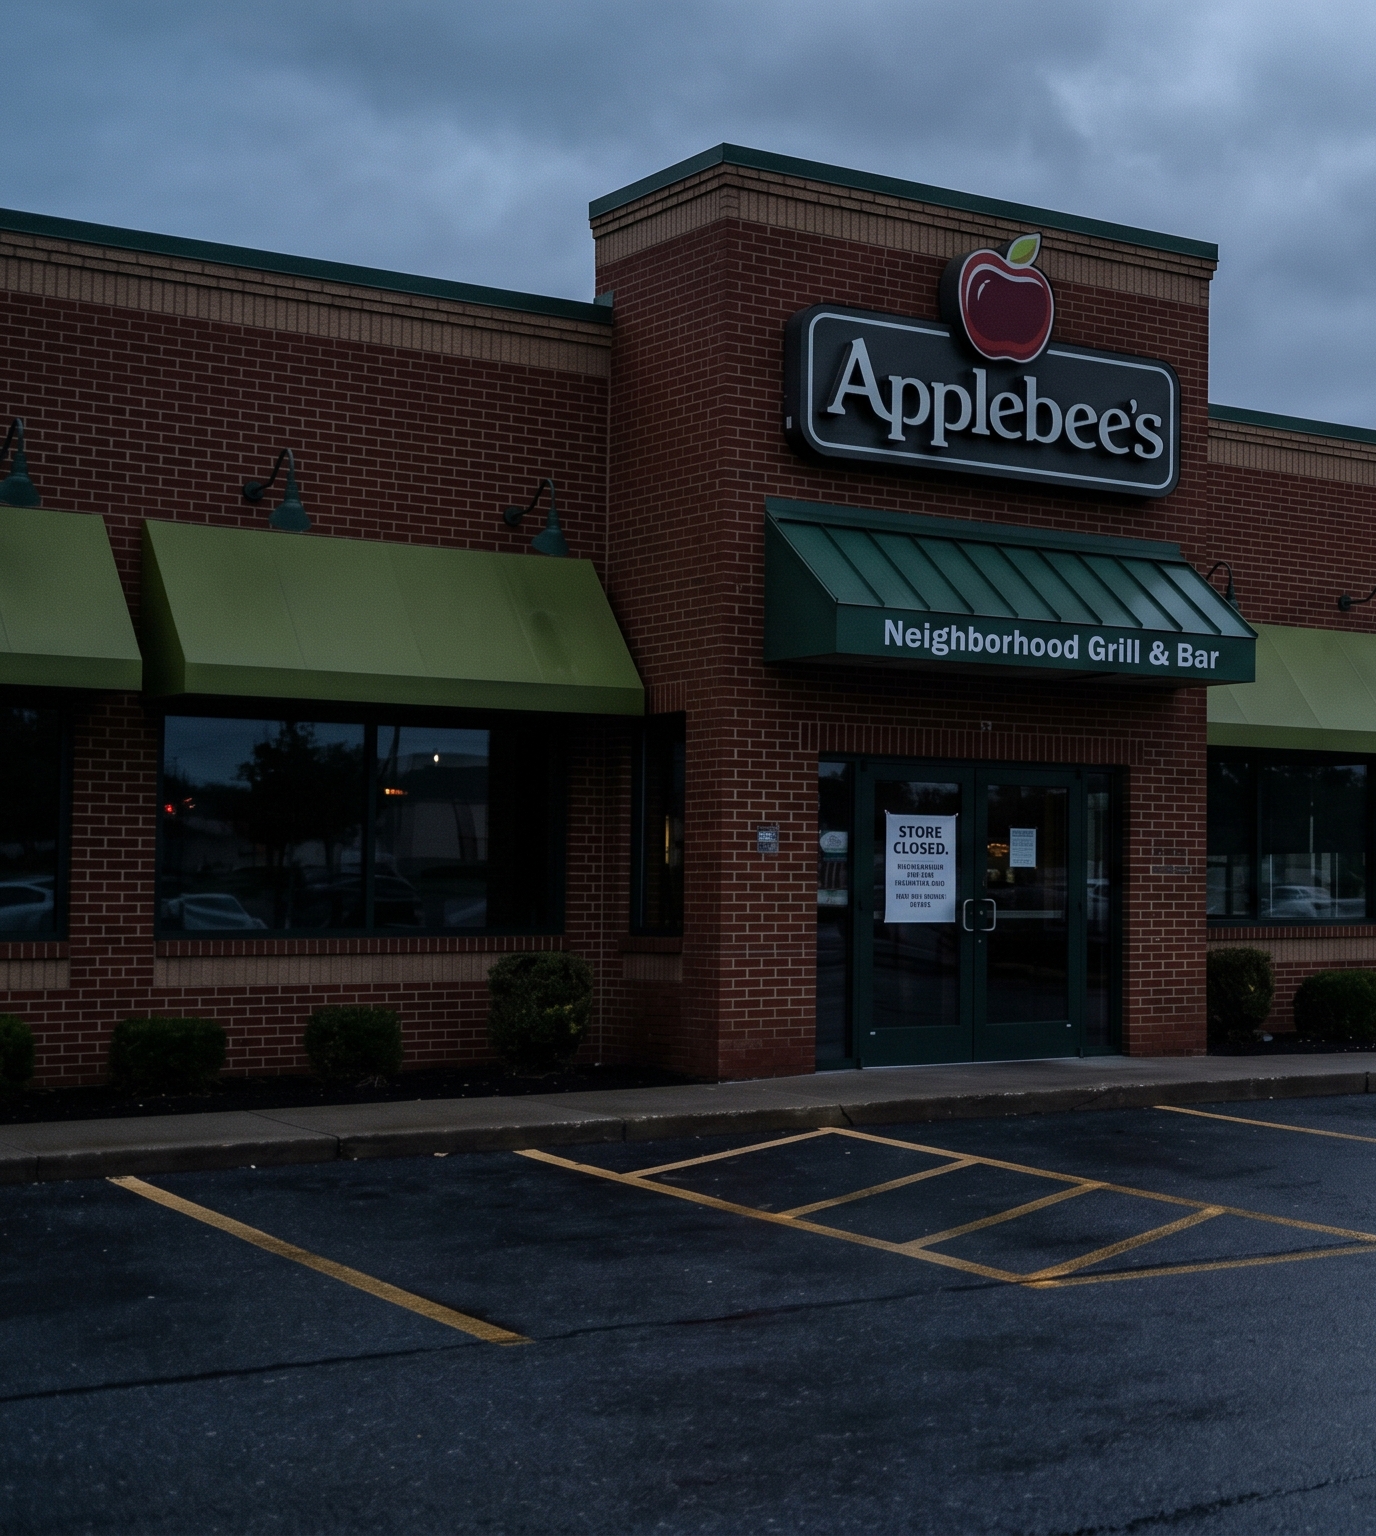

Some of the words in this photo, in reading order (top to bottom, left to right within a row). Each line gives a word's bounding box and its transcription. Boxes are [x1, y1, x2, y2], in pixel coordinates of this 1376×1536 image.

[826, 337, 1164, 459] Applebee's
[883, 619, 1079, 660] Neighborhood
[1087, 635, 1140, 664] Grill
[1148, 641, 1169, 666] &
[1177, 644, 1219, 669] Bar
[898, 825, 942, 838] STORE
[893, 841, 949, 855] CLOSED.
